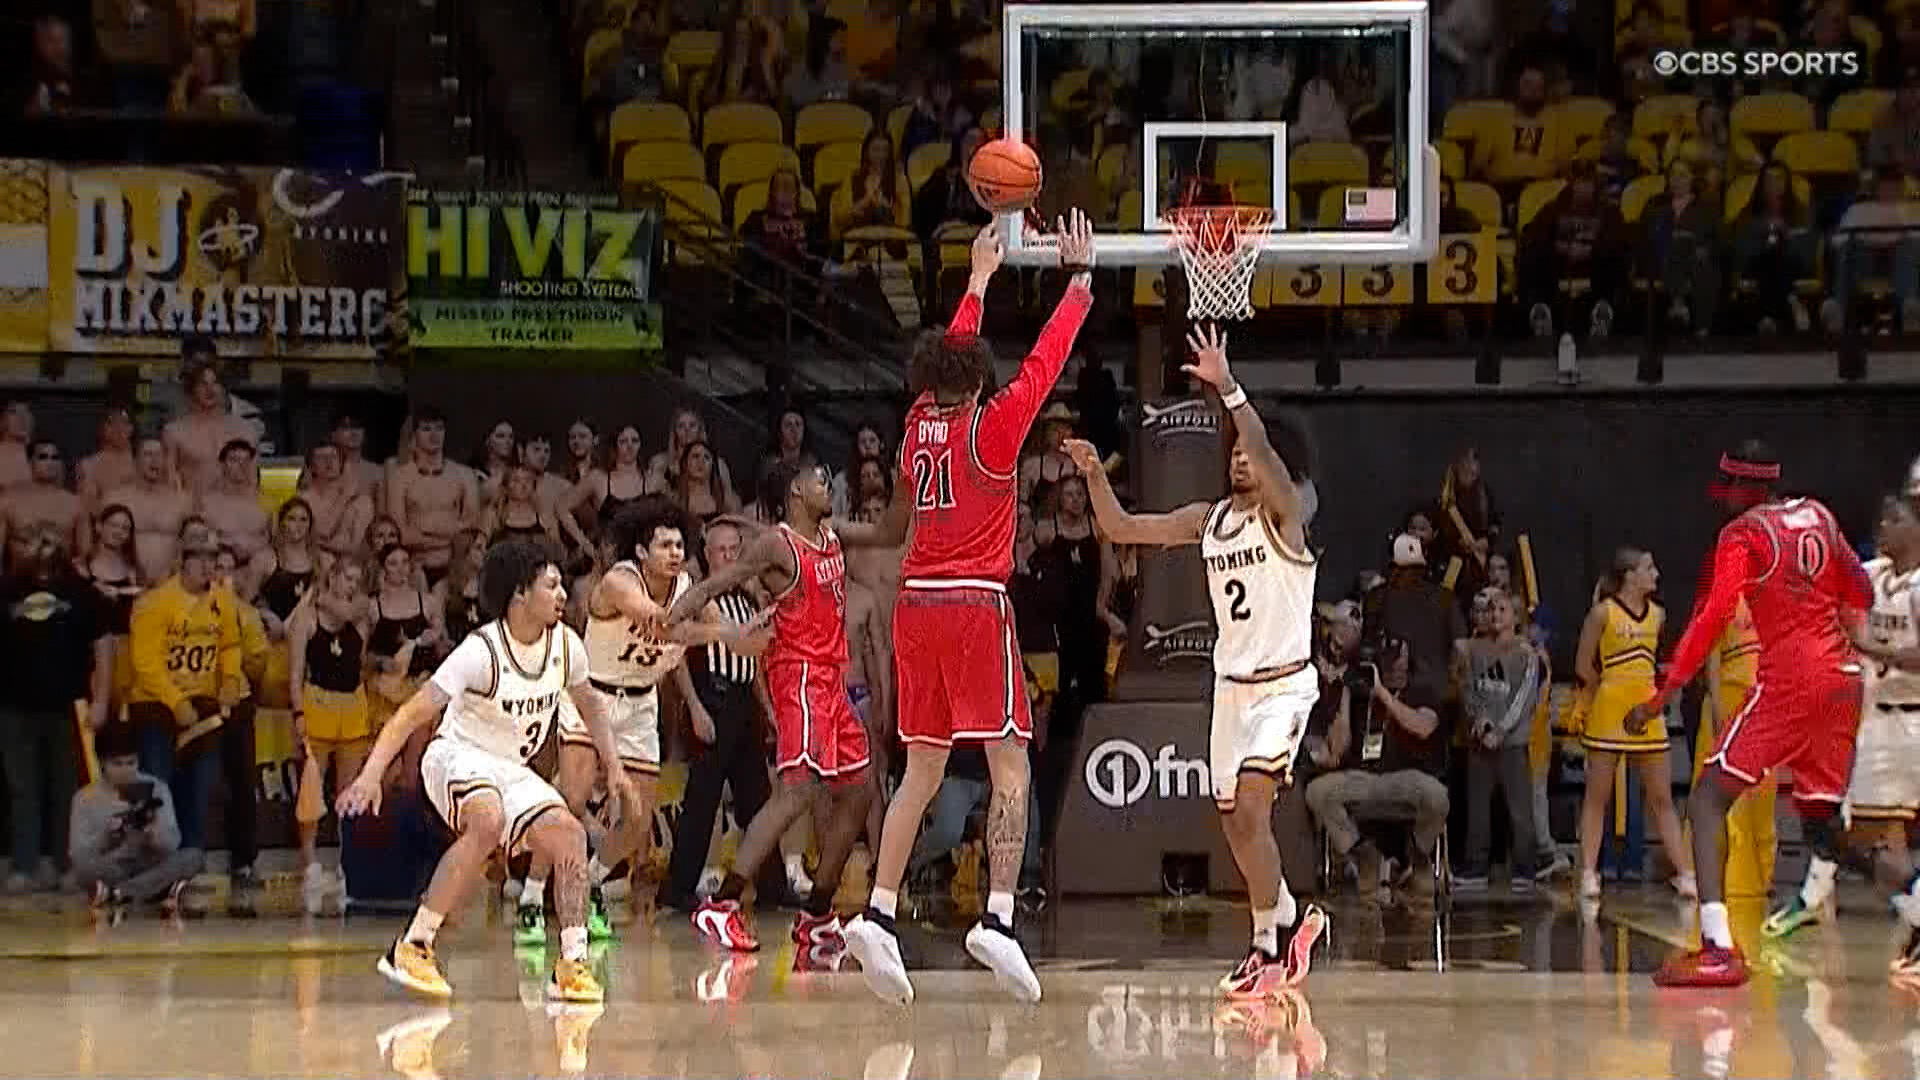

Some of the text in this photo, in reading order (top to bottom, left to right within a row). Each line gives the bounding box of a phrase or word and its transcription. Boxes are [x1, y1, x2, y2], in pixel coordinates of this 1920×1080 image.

[75, 178, 184, 272] DJ
[407, 206, 649, 280] HI VIZ
[1444, 239, 1479, 296] 3
[500, 278, 643, 299] SHOOTING SYSTEMS
[490, 327, 575, 343] TRACKER
[918, 420, 949, 445] BYRD
[911, 448, 957, 511] 21
[1203, 544, 1267, 573] YOMING
[1797, 529, 1829, 580] 0
[1224, 578, 1252, 622] 2
[616, 642, 664, 668] 13
[1162, 638, 1213, 651] AIRPOR
[519, 720, 542, 758] 3
[1152, 743, 1211, 798] fn
